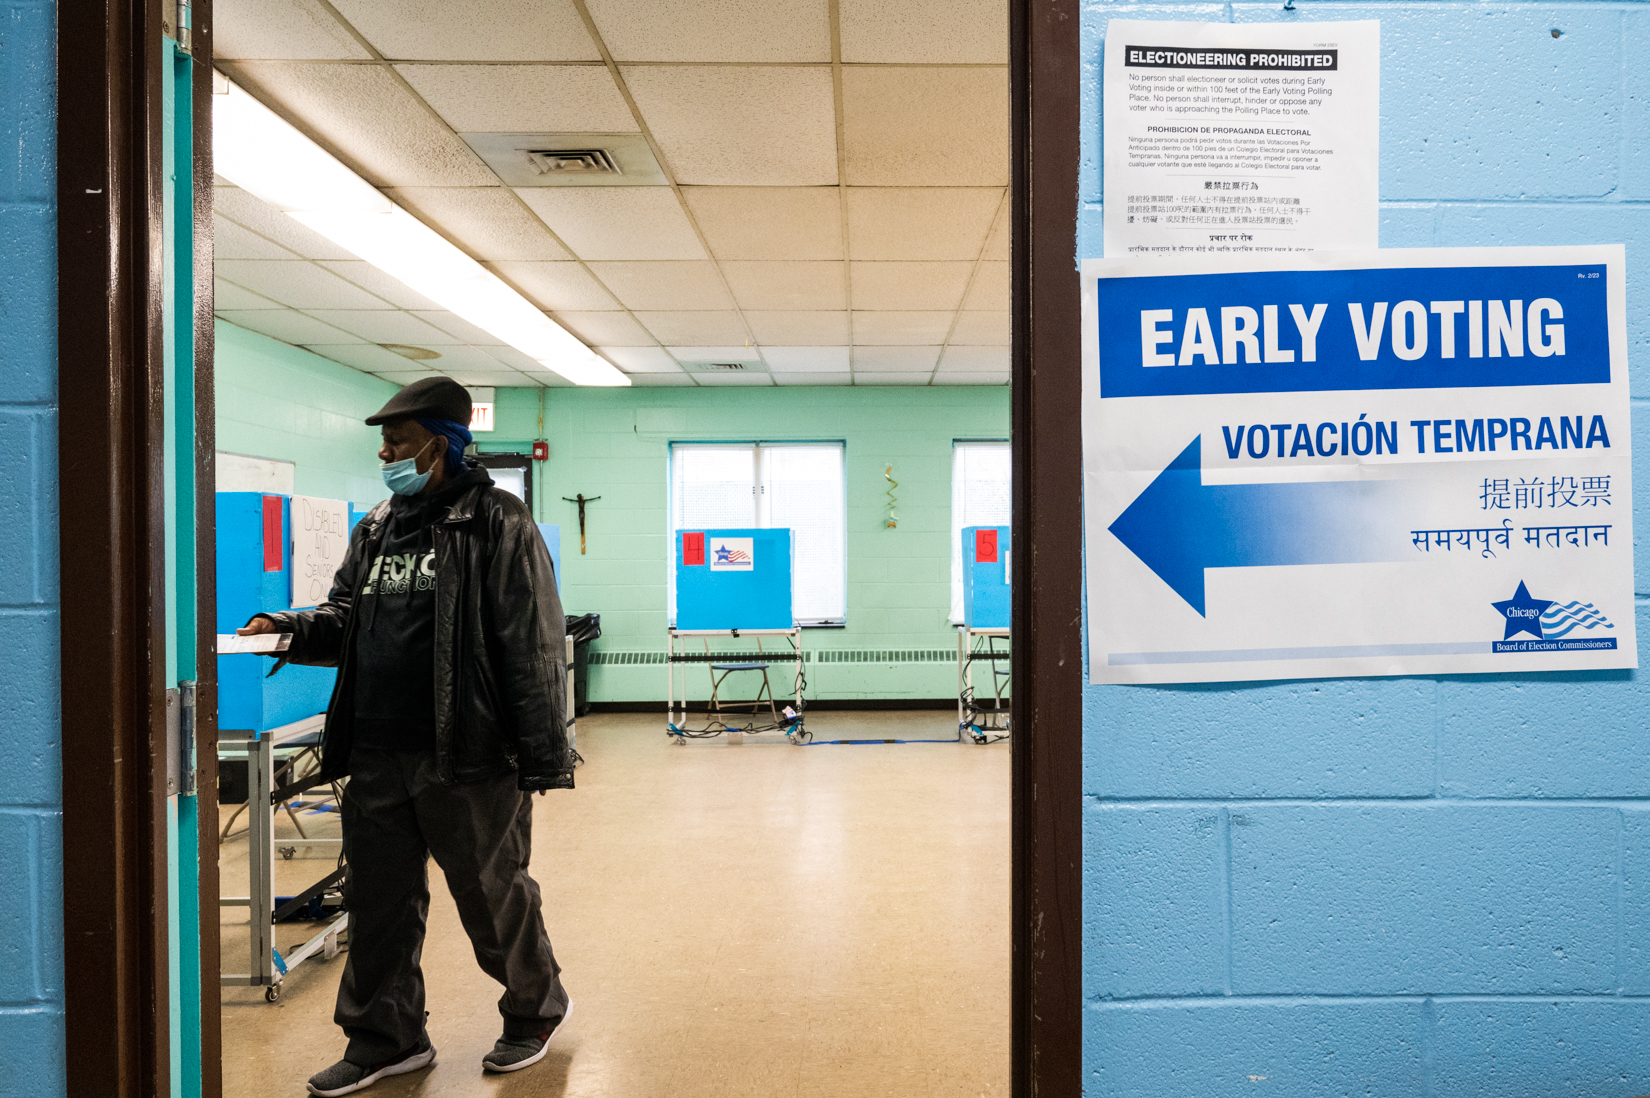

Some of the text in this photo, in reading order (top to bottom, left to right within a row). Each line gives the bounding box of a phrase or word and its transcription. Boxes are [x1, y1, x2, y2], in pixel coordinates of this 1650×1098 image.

[1130, 50, 1333, 67] ELECTIONEERING PROHIBITED
[1141, 75, 1166, 84] person
[1187, 74, 1226, 83] electioneer
[1237, 75, 1258, 83] solicit
[1259, 76, 1280, 84] votes
[1281, 76, 1305, 86] during
[1307, 77, 1326, 87] Early
[1129, 84, 1151, 93] Voting
[1262, 86, 1280, 96] Early
[1282, 86, 1306, 96] Voting
[1308, 87, 1332, 97] Polling
[1166, 96, 1191, 104] person
[1211, 95, 1243, 105] interrupt,
[1279, 98, 1307, 107] oppose
[1308, 99, 1322, 107] any
[1174, 105, 1220, 115] approaching
[1235, 106, 1258, 116] Polling
[1128, 136, 1153, 144] Ninguna
[1128, 144, 1160, 153] Anticipado
[1236, 147, 1258, 155] Colegio
[1129, 153, 1162, 161] Tempranas.
[1164, 153, 1189, 161] Ninguna
[1230, 155, 1262, 163] interrumpir,
[1264, 155, 1285, 163] impedir
[1128, 161, 1156, 169] cualquier
[1208, 162, 1233, 170] llegando
[1241, 163, 1263, 171] Colegio
[1204, 181, 1258, 190] 嚴禁拉票行為
[1240, 233, 1253, 241] रोक
[1140, 298, 1566, 368] EARLY VOTING
[470, 407, 488, 426] XIT
[1222, 414, 1611, 459] VOTACIÓN TEMPRANA
[1479, 475, 1611, 510] 提前投票
[1411, 518, 1612, 558] समयपूर्व मतदान
[688, 536, 702, 560] 4
[979, 534, 994, 556] 5
[310, 579, 332, 601] ONL
[1506, 607, 1539, 619] Chicago
[1497, 643, 1518, 651] Board
[1520, 642, 1527, 650] of
[1559, 641, 1612, 649] Commissioners
